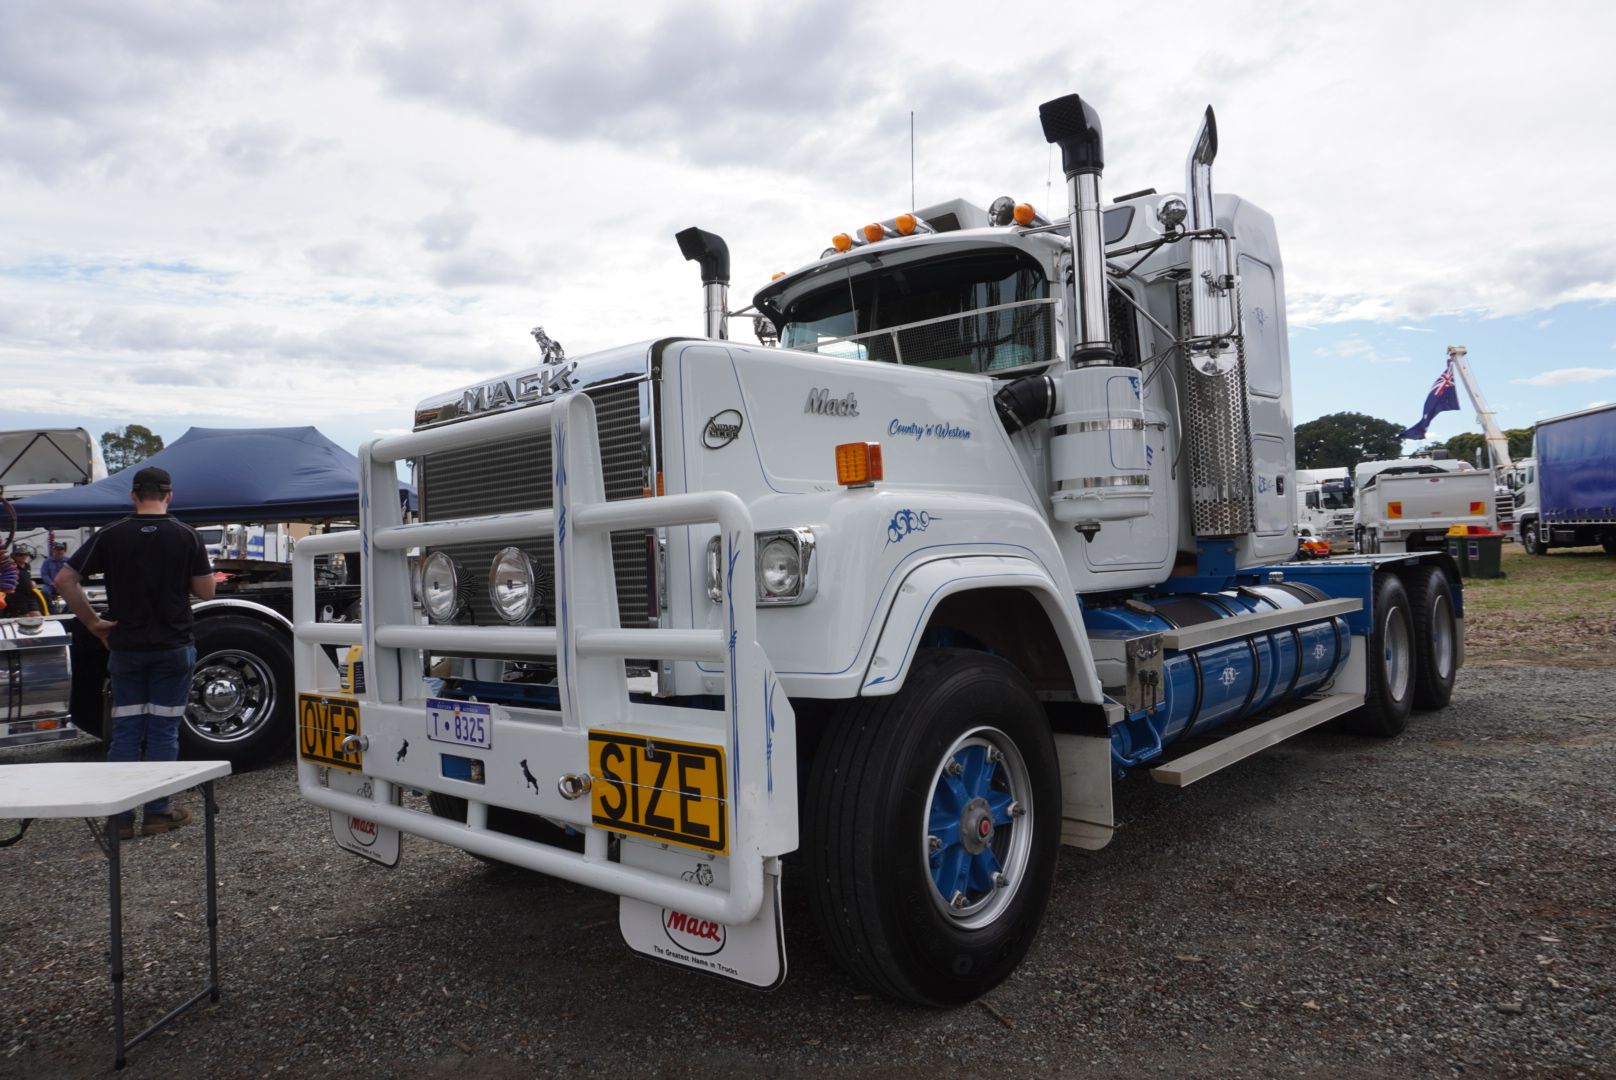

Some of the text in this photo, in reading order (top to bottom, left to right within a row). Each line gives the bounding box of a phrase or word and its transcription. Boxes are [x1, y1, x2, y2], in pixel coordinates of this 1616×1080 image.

[463, 363, 574, 413] MACK
[804, 387, 860, 417] Mack
[889, 418, 924, 441] Country
[935, 421, 971, 439] Western
[304, 700, 361, 764] OVER
[455, 715, 485, 743] 8325
[600, 742, 710, 838] SIZE
[667, 910, 721, 943] Mack
[653, 945, 664, 954] The
[665, 949, 690, 961] Greatest
[691, 956, 709, 967] Name
[717, 963, 738, 975] Trucks
